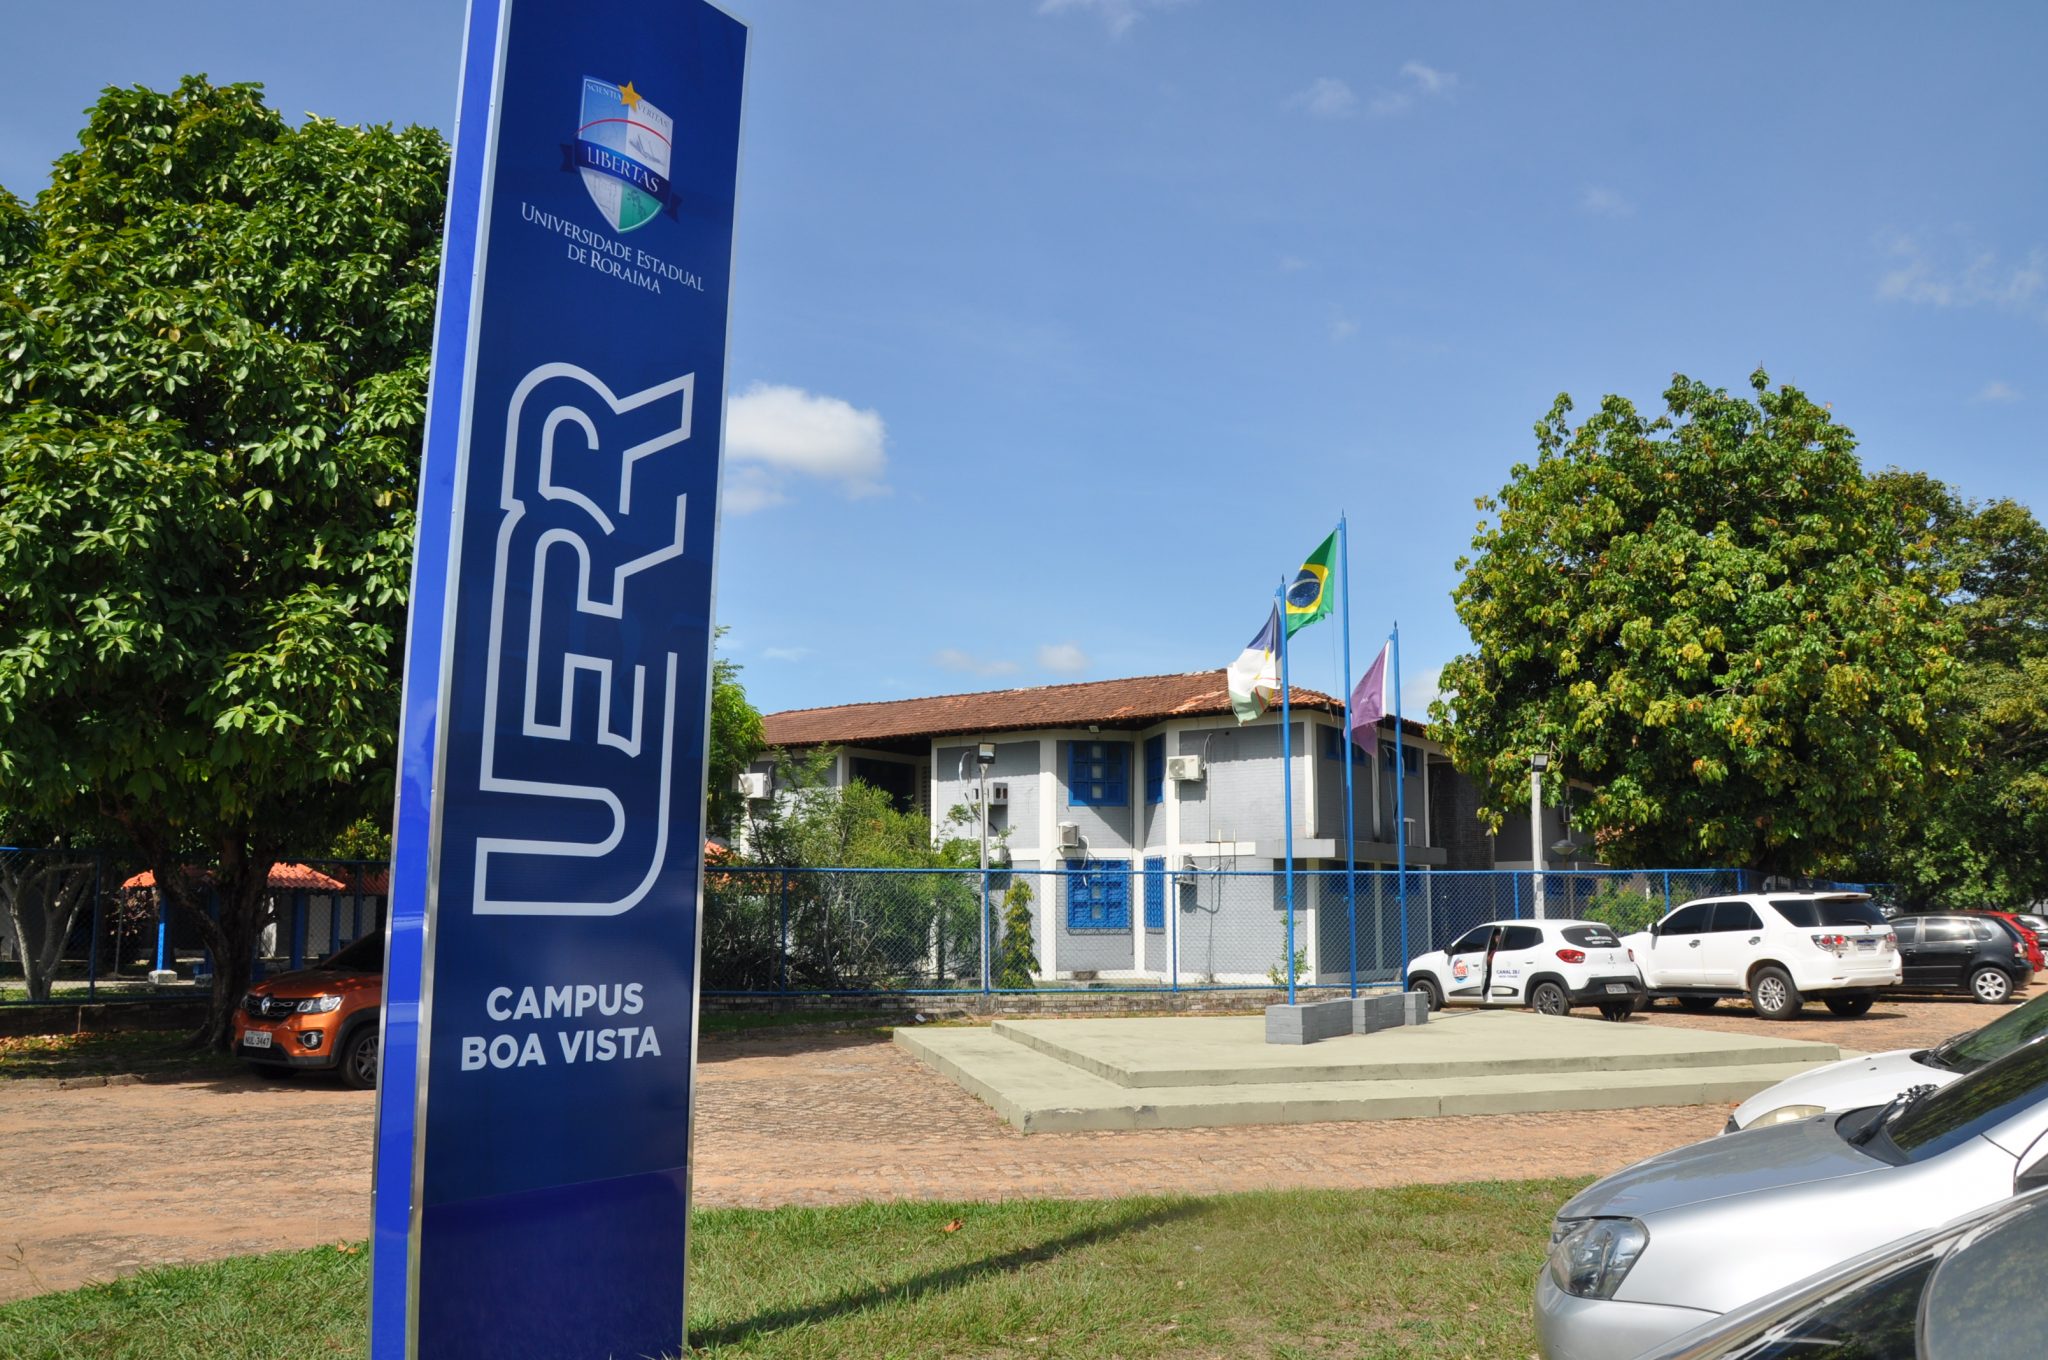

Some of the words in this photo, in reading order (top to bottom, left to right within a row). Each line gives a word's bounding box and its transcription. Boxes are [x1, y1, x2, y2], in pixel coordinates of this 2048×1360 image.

[587, 146, 660, 192] LIBERTAS
[521, 202, 632, 263] UNIVERSIDADE
[636, 250, 705, 292] ESTADUAL
[567, 244, 587, 265] DE
[590, 251, 661, 294] RORAIMA
[486, 982, 644, 1022] CAMPUS
[460, 1032, 547, 1071] BOA
[557, 1025, 662, 1064] VISTA
